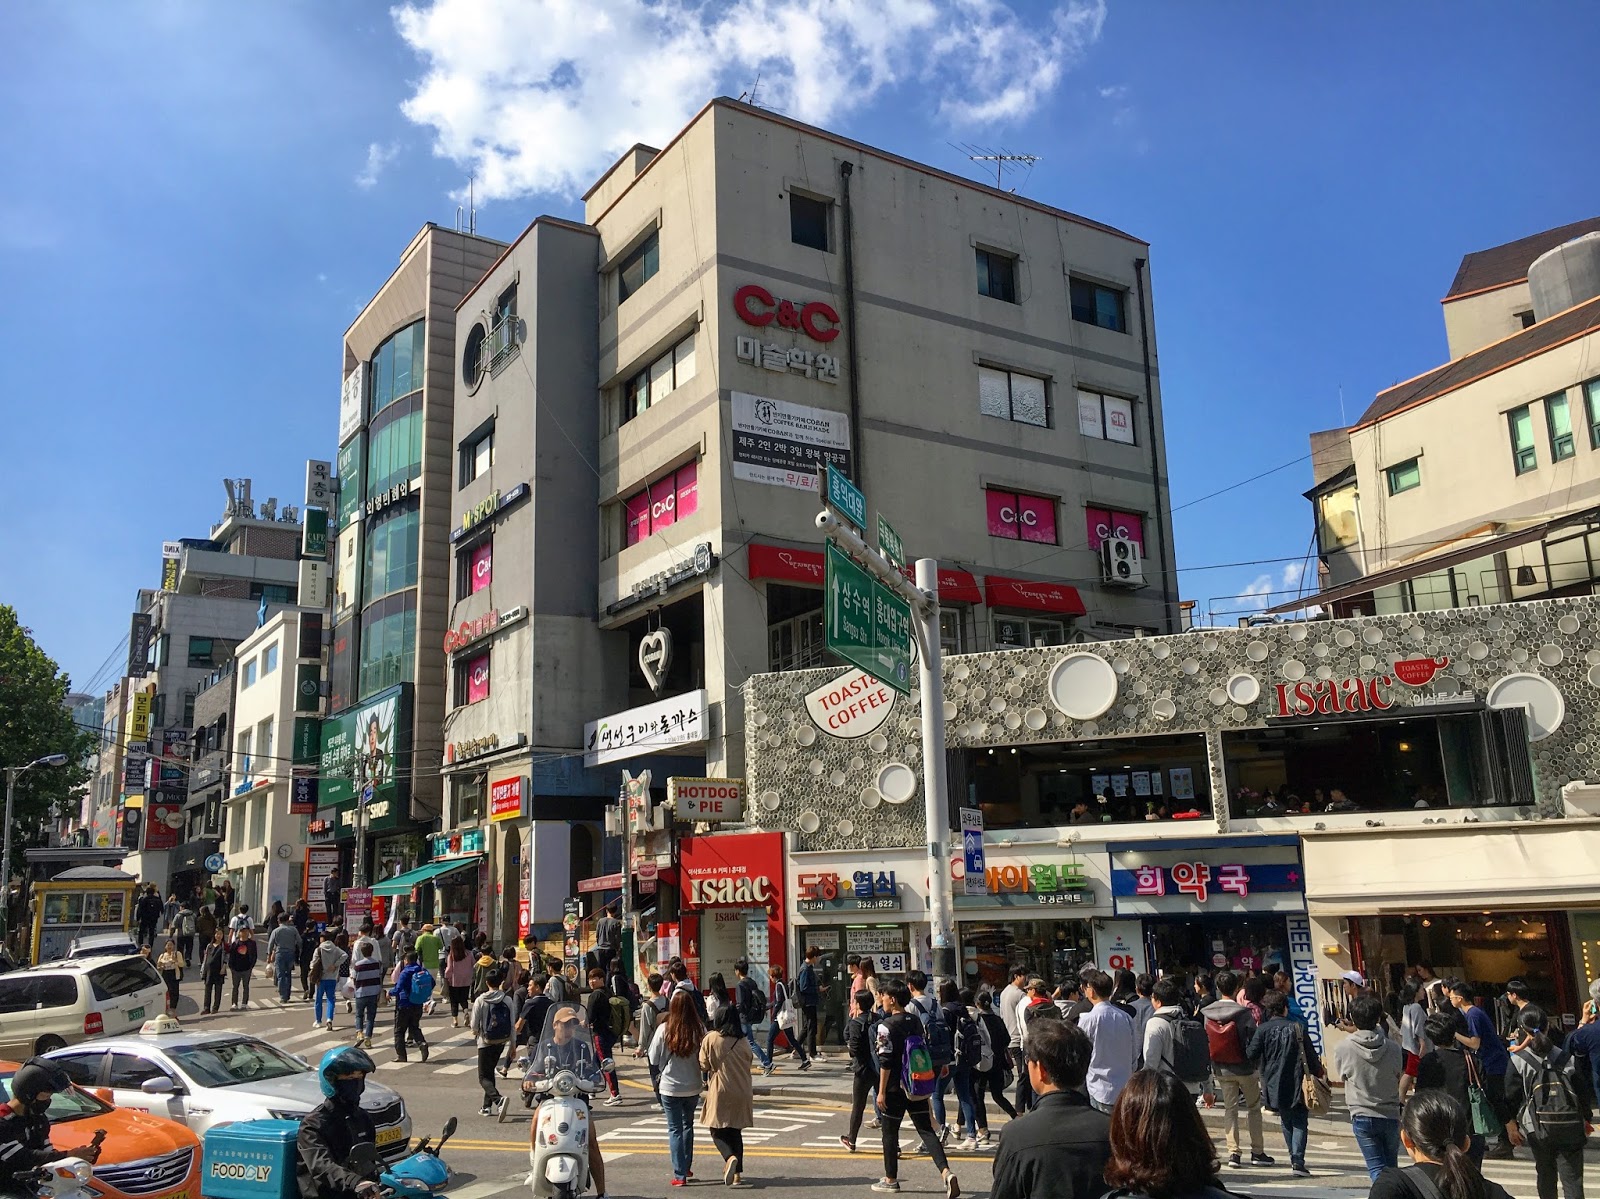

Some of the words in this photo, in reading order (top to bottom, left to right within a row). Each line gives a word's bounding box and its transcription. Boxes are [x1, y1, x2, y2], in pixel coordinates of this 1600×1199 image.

[734, 284, 841, 342] C&C
[736, 335, 840, 385] 미술학원
[738, 436, 755, 448] 제주
[758, 440, 771, 451] 2인
[774, 442, 787, 454] 2박
[789, 445, 802, 457] 3일
[805, 448, 821, 460] 왕복
[823, 451, 846, 464] 항공권
[653, 494, 675, 518] C&C
[832, 474, 863, 521] 홍익대앞
[1000, 507, 1037, 526] C&C
[842, 581, 870, 624] 상수역
[842, 615, 859, 640] Sangsu
[876, 596, 909, 643] 홍대입구역
[443, 621, 469, 654] C&C
[1401, 662, 1430, 672] TOAST&
[1402, 671, 1430, 679] COFFEE
[828, 688, 890, 730] COFFEE
[1412, 690, 1476, 706] 이삭토스트
[136, 697, 147, 732] 보드카페
[677, 786, 738, 799] HOTDOG
[341, 809, 353, 826] THE
[699, 801, 723, 813] PIE
[688, 867, 712, 875] 이삭토스트
[1136, 862, 1250, 902] 희약국
[797, 872, 840, 900] 도장
[853, 870, 896, 898] 열쇠
[1288, 918, 1312, 953] HEE
[880, 955, 902, 971] 열쇠
[1241, 957, 1254, 969] 약
